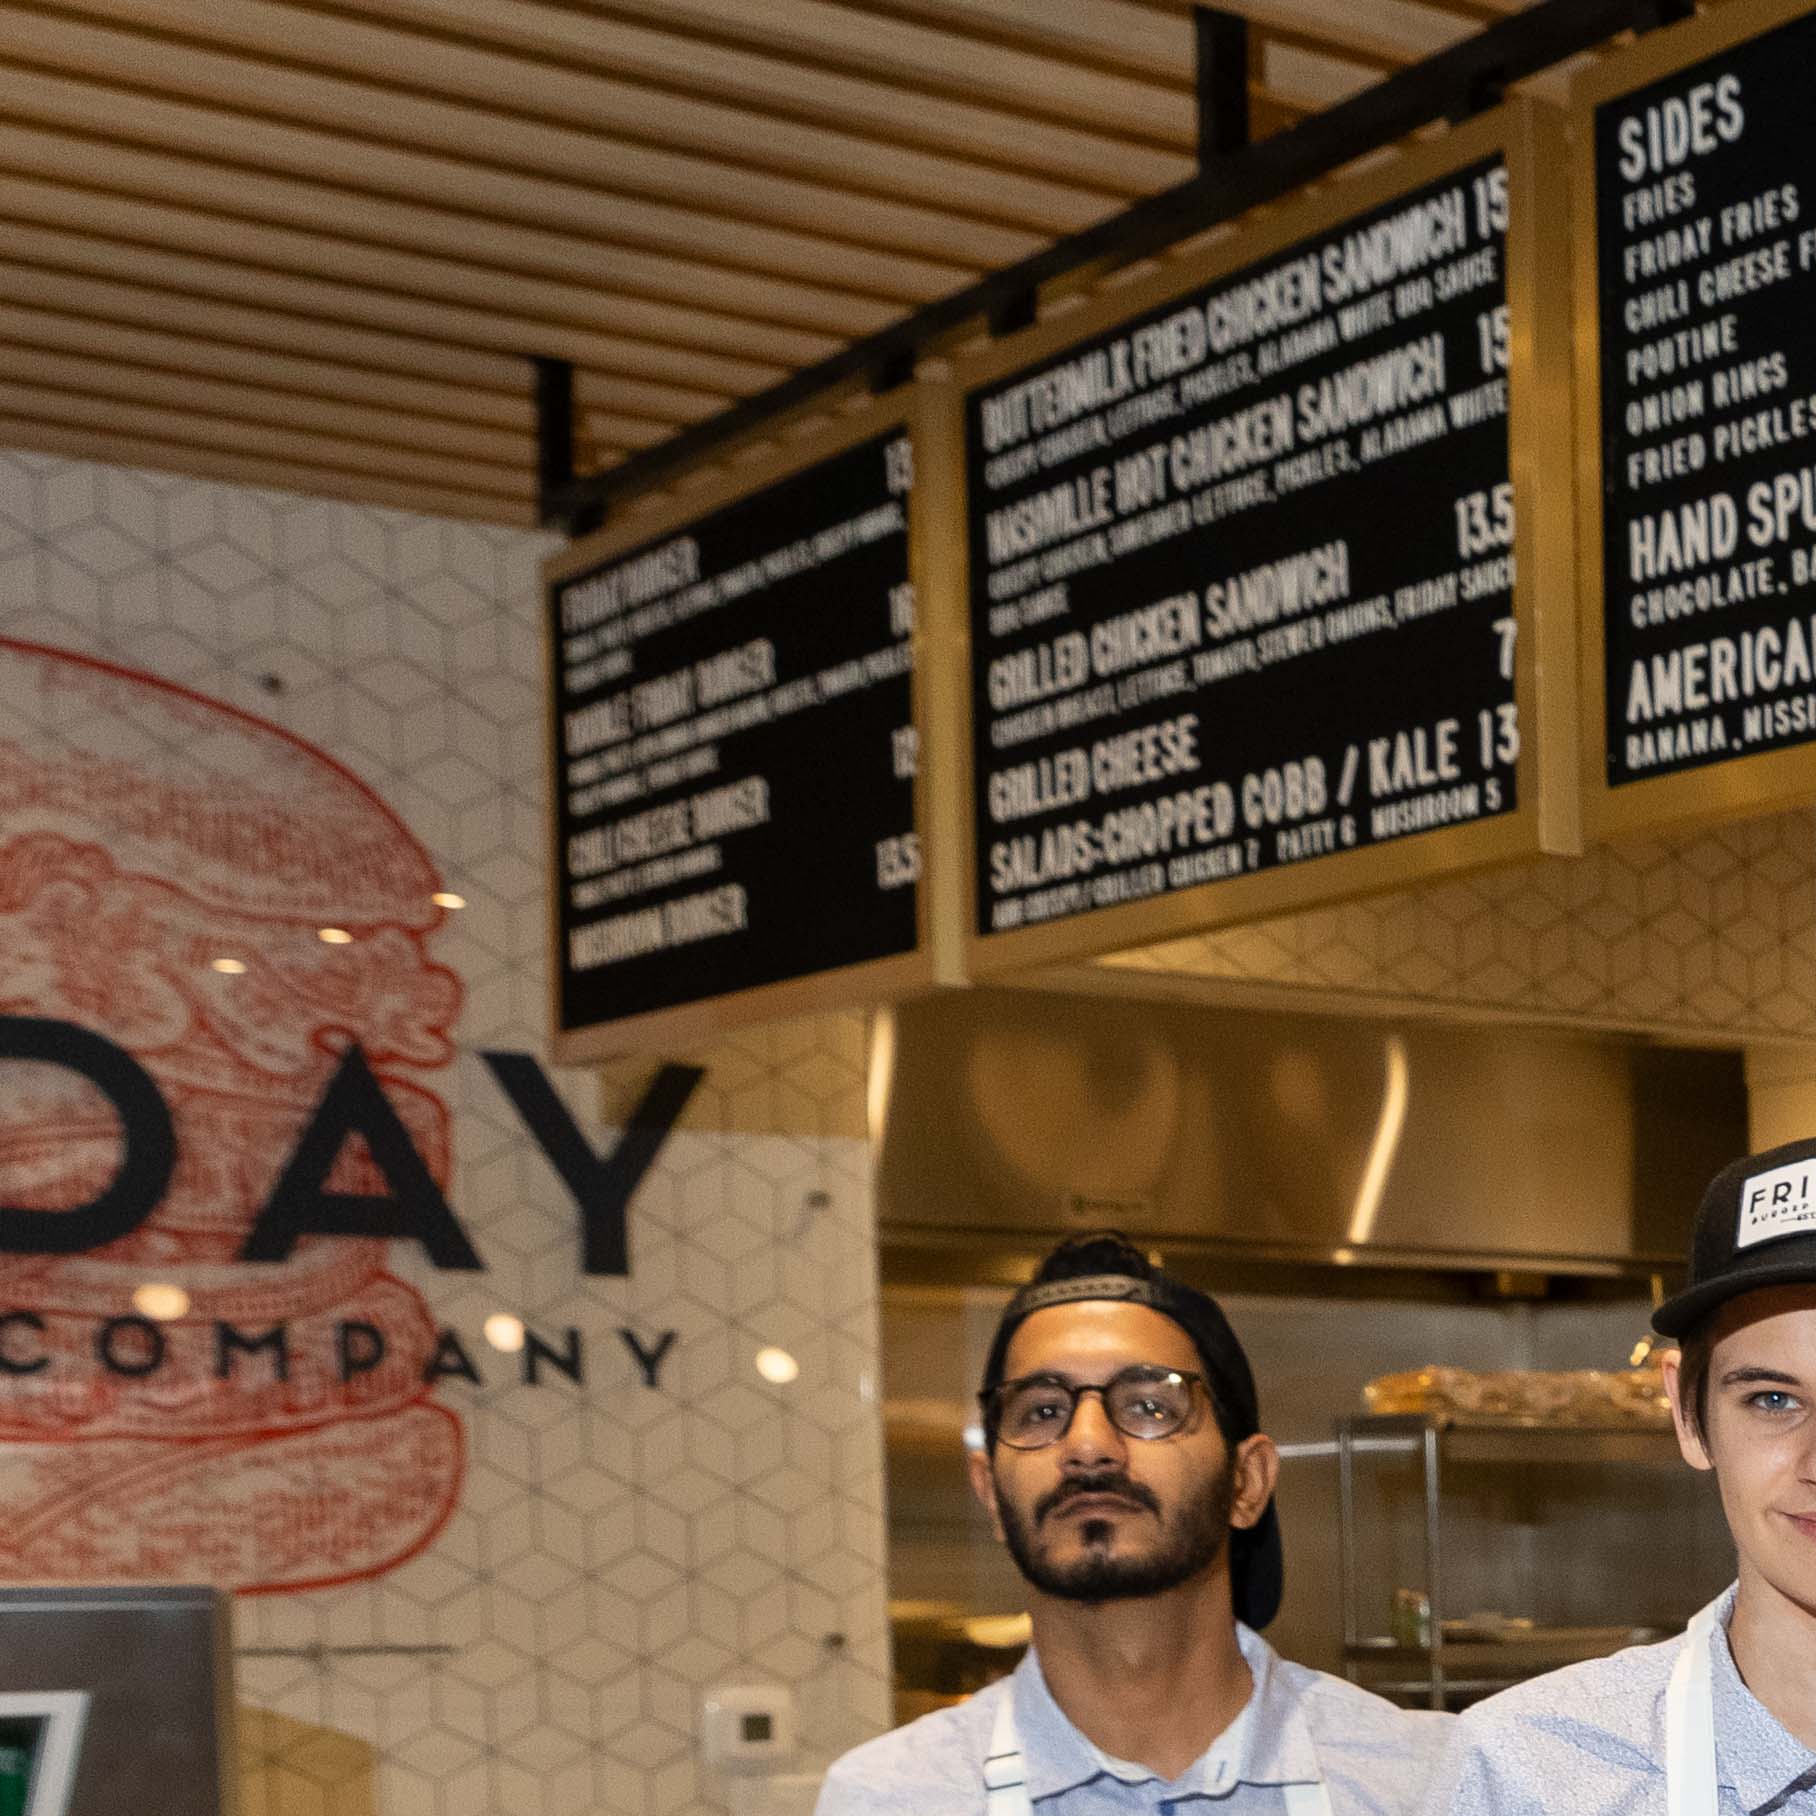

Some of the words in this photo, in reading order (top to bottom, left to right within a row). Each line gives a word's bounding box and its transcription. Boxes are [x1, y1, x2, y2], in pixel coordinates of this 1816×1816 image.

[1617, 68, 1744, 187] SIDES
[1322, 184, 1465, 308] SANDWICH
[1473, 162, 1509, 243] 15
[1623, 168, 1695, 233] FRIES
[1623, 215, 1711, 286] FRIDAY
[1720, 181, 1799, 247] FRIES
[1624, 278, 1689, 336] CHILI
[1698, 238, 1791, 309] CHEESE
[1170, 390, 1293, 496] CHICKEN
[1296, 328, 1445, 447] SANDWICH
[1476, 302, 1511, 378] 15
[1625, 378, 1704, 440] ONION
[1712, 350, 1787, 411] RINGS
[1626, 311, 1738, 387] POUTINE
[1627, 430, 1706, 490] FRIED
[1204, 536, 1349, 643] SANDWICH
[1454, 479, 1513, 563] 13.5
[1628, 489, 1738, 584] HAND
[1091, 710, 1201, 798] CHEESE
[1492, 614, 1515, 686] 7
[1240, 751, 1327, 833] COBB
[1368, 715, 1461, 800] KALE
[1478, 699, 1518, 771] 13
